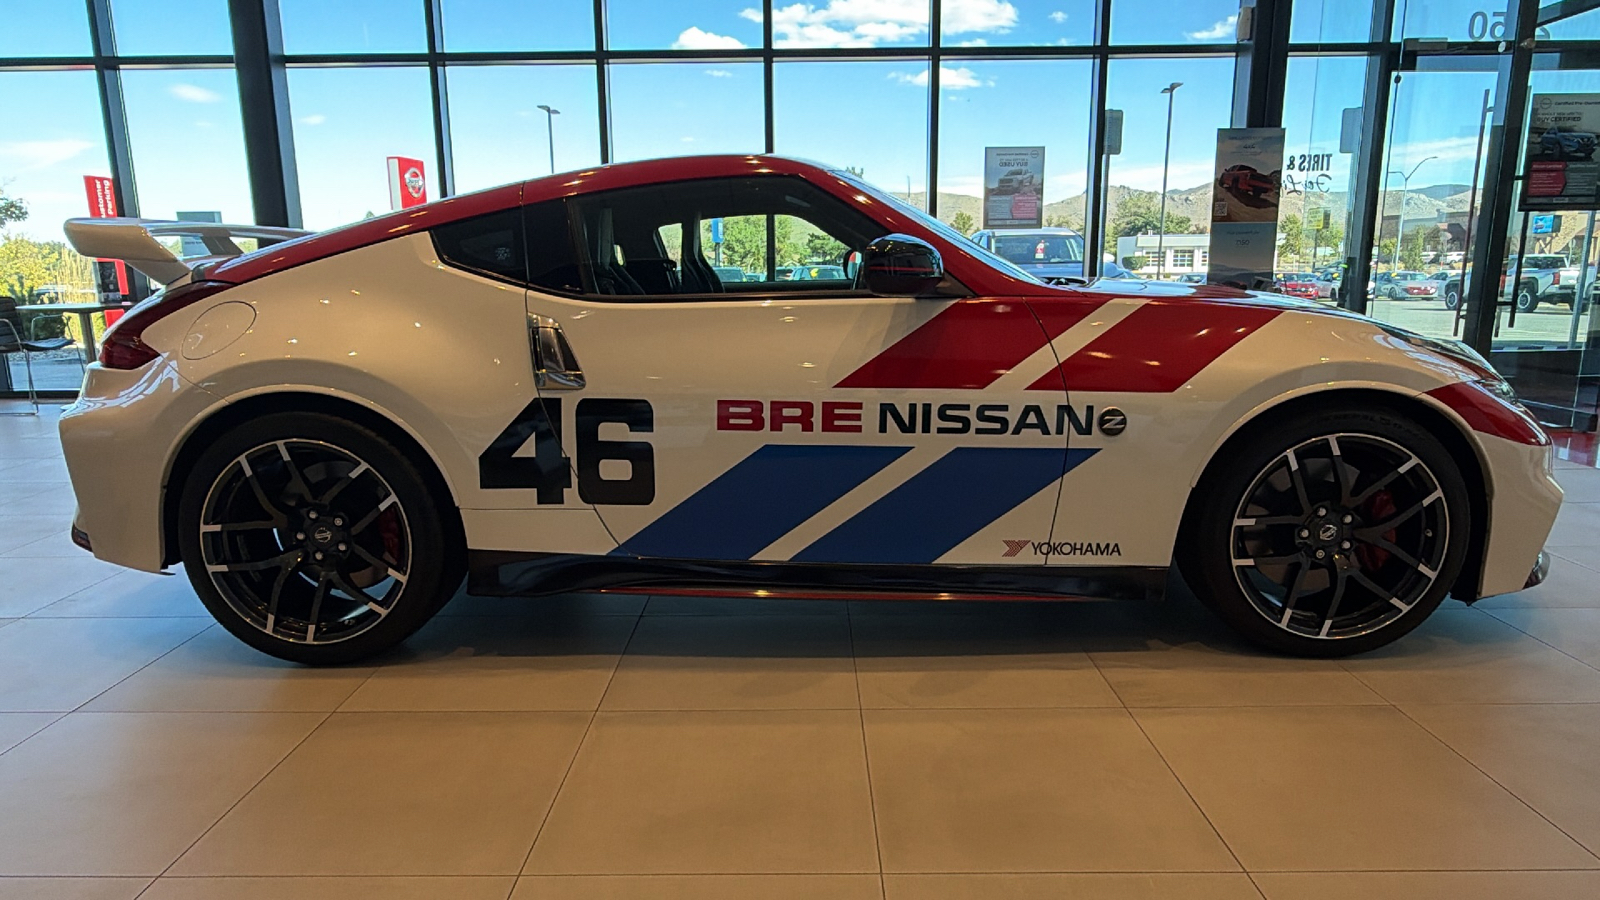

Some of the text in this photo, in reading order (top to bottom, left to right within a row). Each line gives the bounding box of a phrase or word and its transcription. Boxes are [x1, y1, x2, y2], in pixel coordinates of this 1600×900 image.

[95, 179, 106, 218] ustomer
[103, 179, 113, 215] Parking
[717, 400, 1094, 436] BRE NISSAN
[479, 397, 655, 505] 46
[1031, 542, 1121, 556] YOKOHAMA
